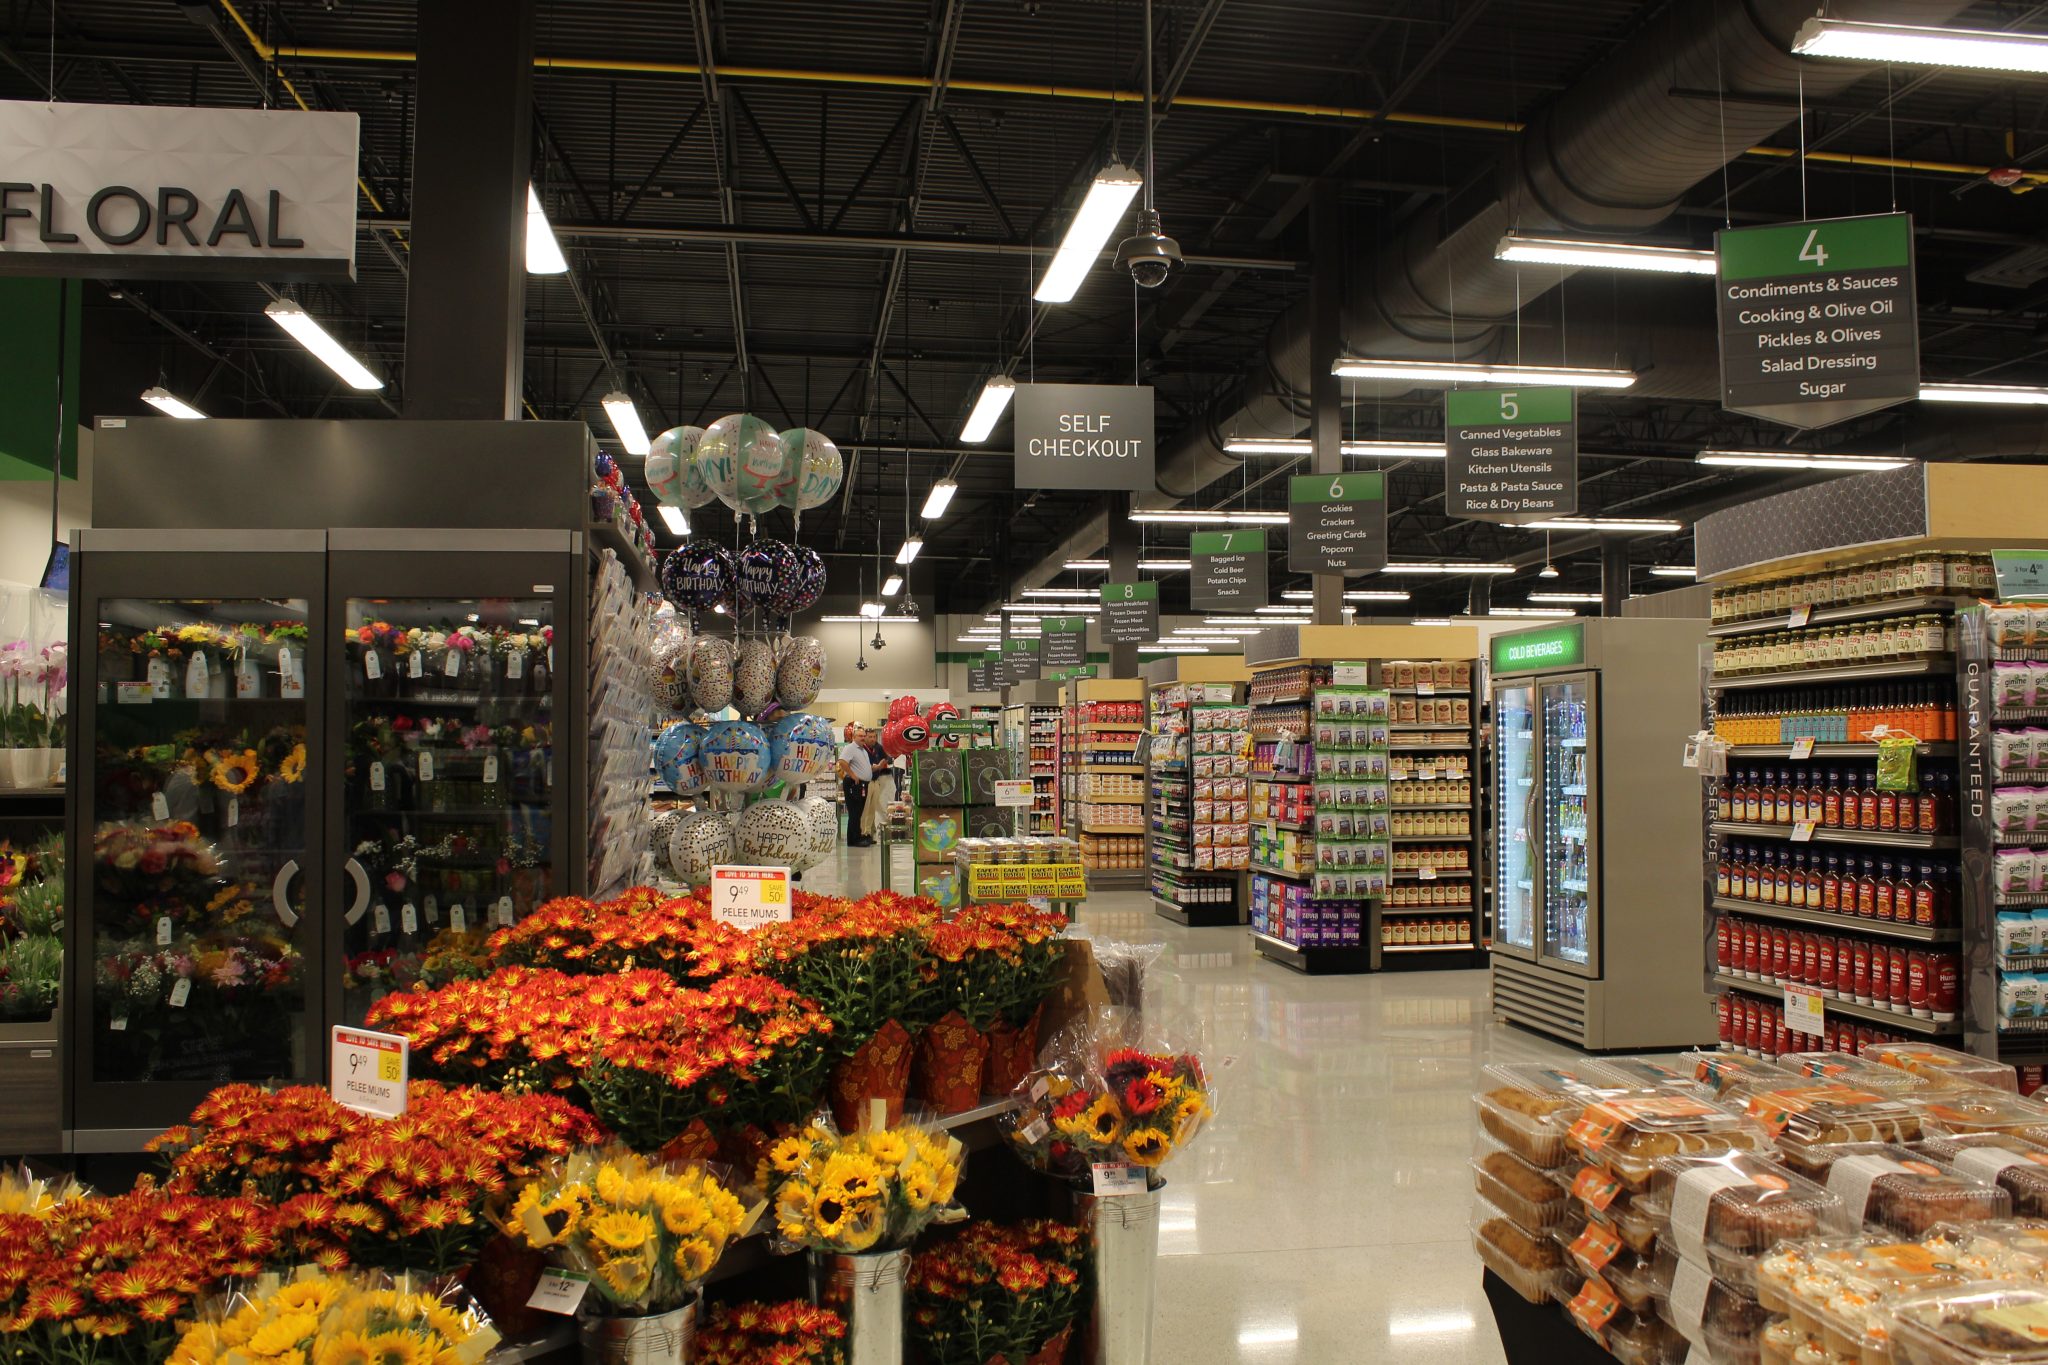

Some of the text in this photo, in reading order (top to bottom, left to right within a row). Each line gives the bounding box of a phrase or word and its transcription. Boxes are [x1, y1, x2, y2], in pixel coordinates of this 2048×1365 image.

[0, 182, 304, 248] FLORAL
[1798, 229, 1829, 266] 4
[1727, 274, 1898, 300] Condiments & Sauces
[1739, 299, 1893, 325] Cooking & Olive Oil
[1758, 327, 1881, 348] Pickles & Olives
[1761, 353, 1877, 373] Salad Dressing
[1800, 381, 1847, 398] Sugar
[1500, 393, 1519, 421] 5
[1059, 414, 1111, 433] SELF
[1460, 427, 1562, 441] Canned Vegetables
[1029, 438, 1141, 458] CHECKOUT
[1471, 446, 1553, 458] Glass Bakeware
[1468, 462, 1552, 474] Kitchen Utensils
[1329, 477, 1344, 499] 6
[1460, 481, 1563, 493] Pasta & Pasta Sauce
[1321, 504, 1353, 514] Cookies
[1466, 498, 1554, 511] Rice & Dry Beans
[1320, 517, 1355, 527] Crackers
[1222, 534, 1233, 550] 7
[1307, 530, 1367, 541] Greeting Cards
[1320, 545, 1354, 555] Popcorn
[1210, 555, 1235, 563] Bagged
[1327, 558, 1347, 567] Nuts
[682, 558, 720, 577] Happy
[743, 559, 773, 581] Happy
[676, 577, 725, 592] BIRTHDAY
[1207, 577, 1247, 585] Potato Chips
[1124, 585, 1133, 598] 8
[1217, 588, 1240, 596] Snacks
[1059, 619, 1067, 630] 9
[1016, 641, 1027, 650] 10
[1509, 640, 1563, 660] COLD BEVERAGES
[2005, 677, 2026, 687] gimme
[1967, 662, 1983, 817] GUARANTEED
[757, 831, 791, 844] HAPPY
[701, 838, 729, 856] HAPPY
[743, 839, 802, 865] Birthday
[722, 907, 779, 919] PELEE MUMS
[346, 1080, 390, 1098] PELEE MUMS
